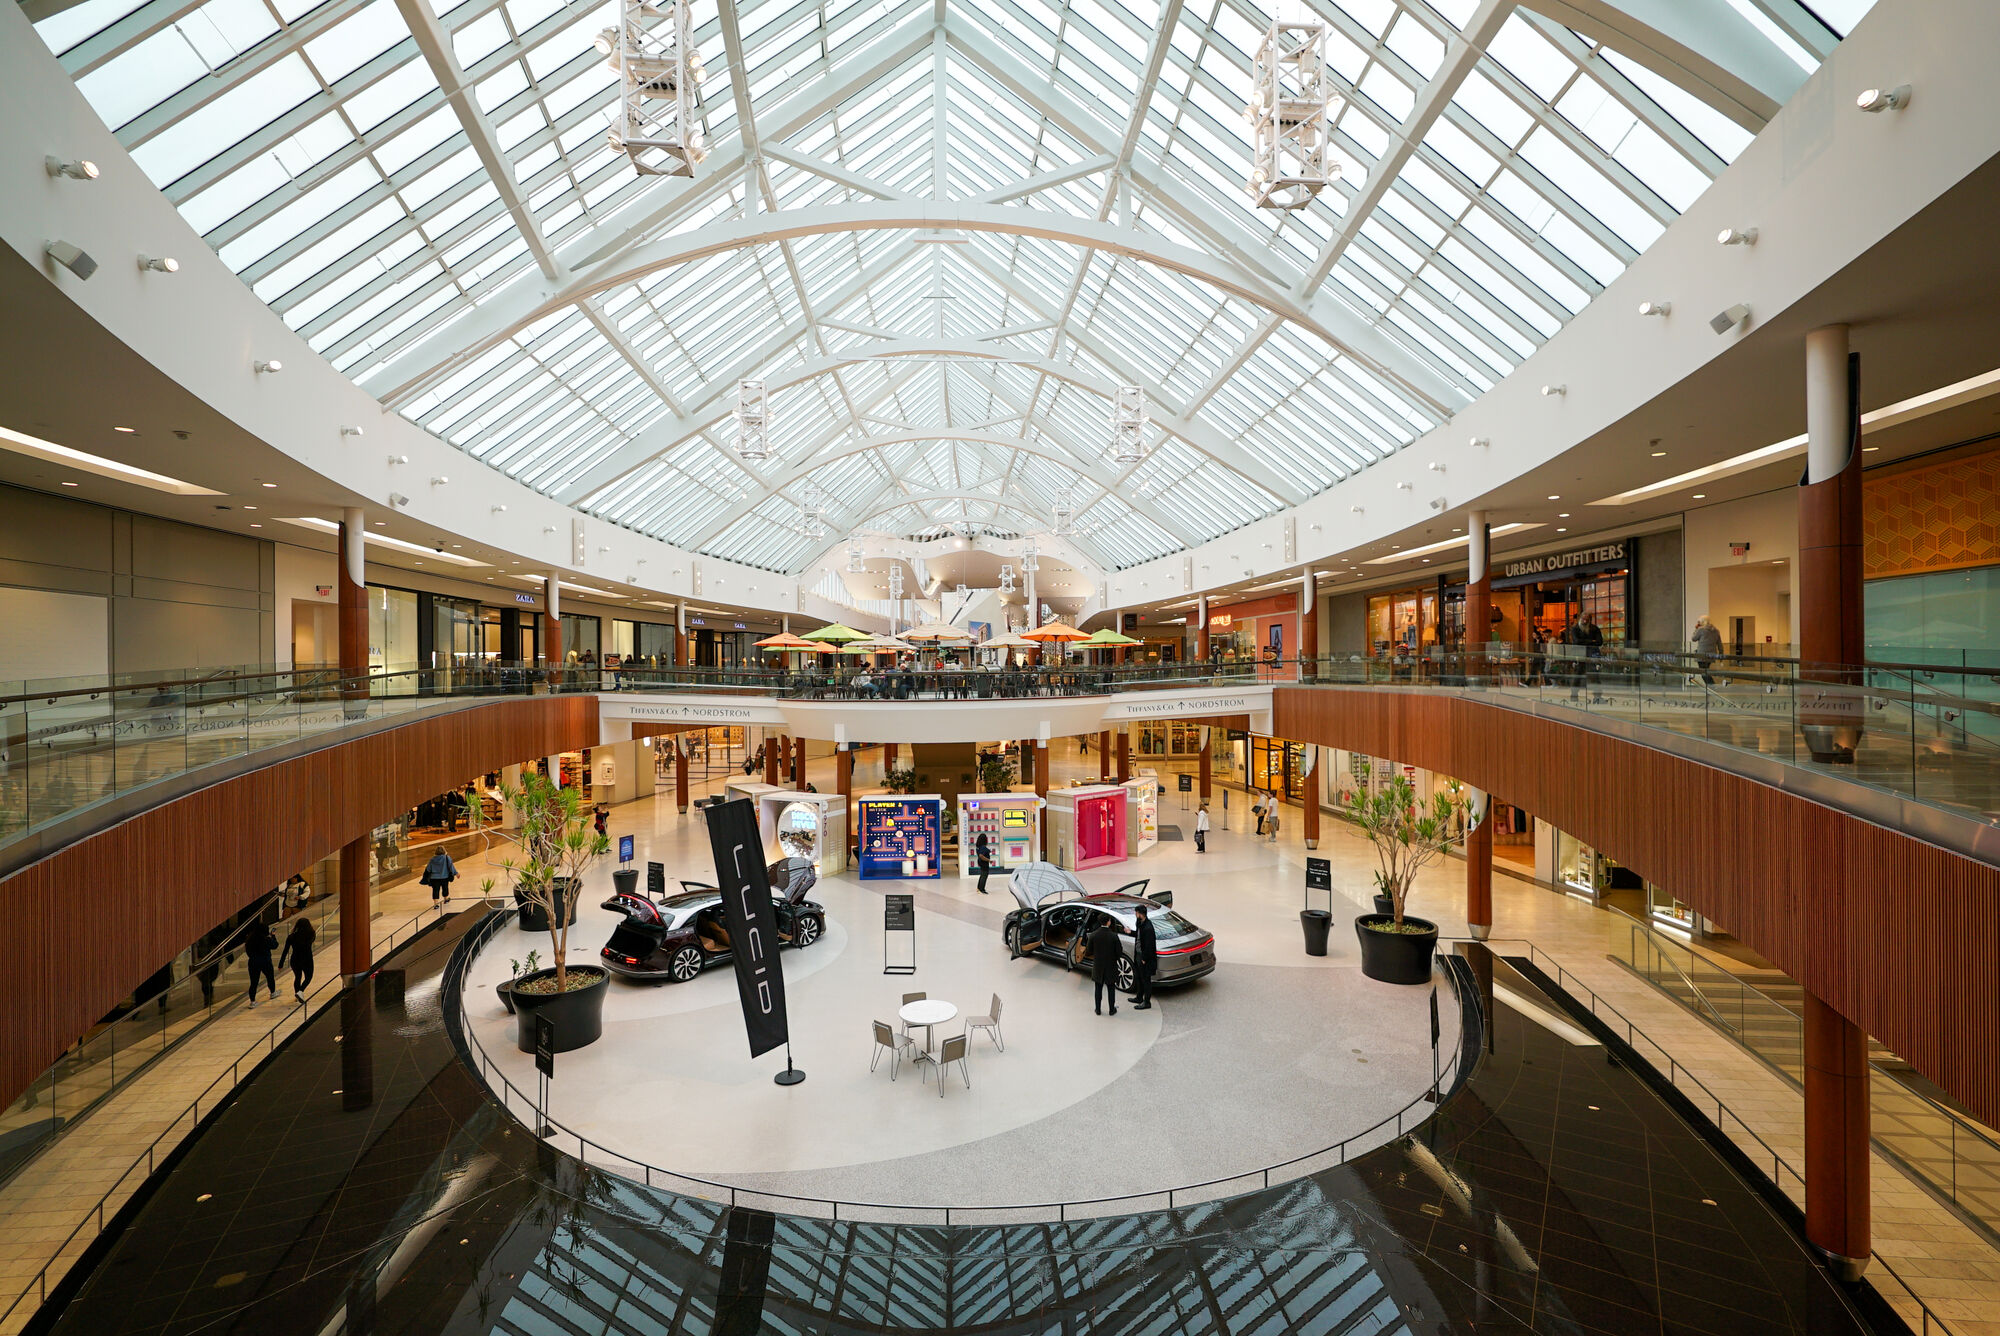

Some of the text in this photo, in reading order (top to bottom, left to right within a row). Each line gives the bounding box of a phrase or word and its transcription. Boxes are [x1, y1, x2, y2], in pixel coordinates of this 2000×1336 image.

[1733, 547, 1744, 556] EXIT
[1505, 543, 1624, 577] URBAN OUTFITTERS
[515, 593, 535, 604] ZARA
[1188, 699, 1245, 709] NORDSTROM
[692, 708, 750, 717] NORDSTROM
[733, 843, 772, 1014] LUCID
